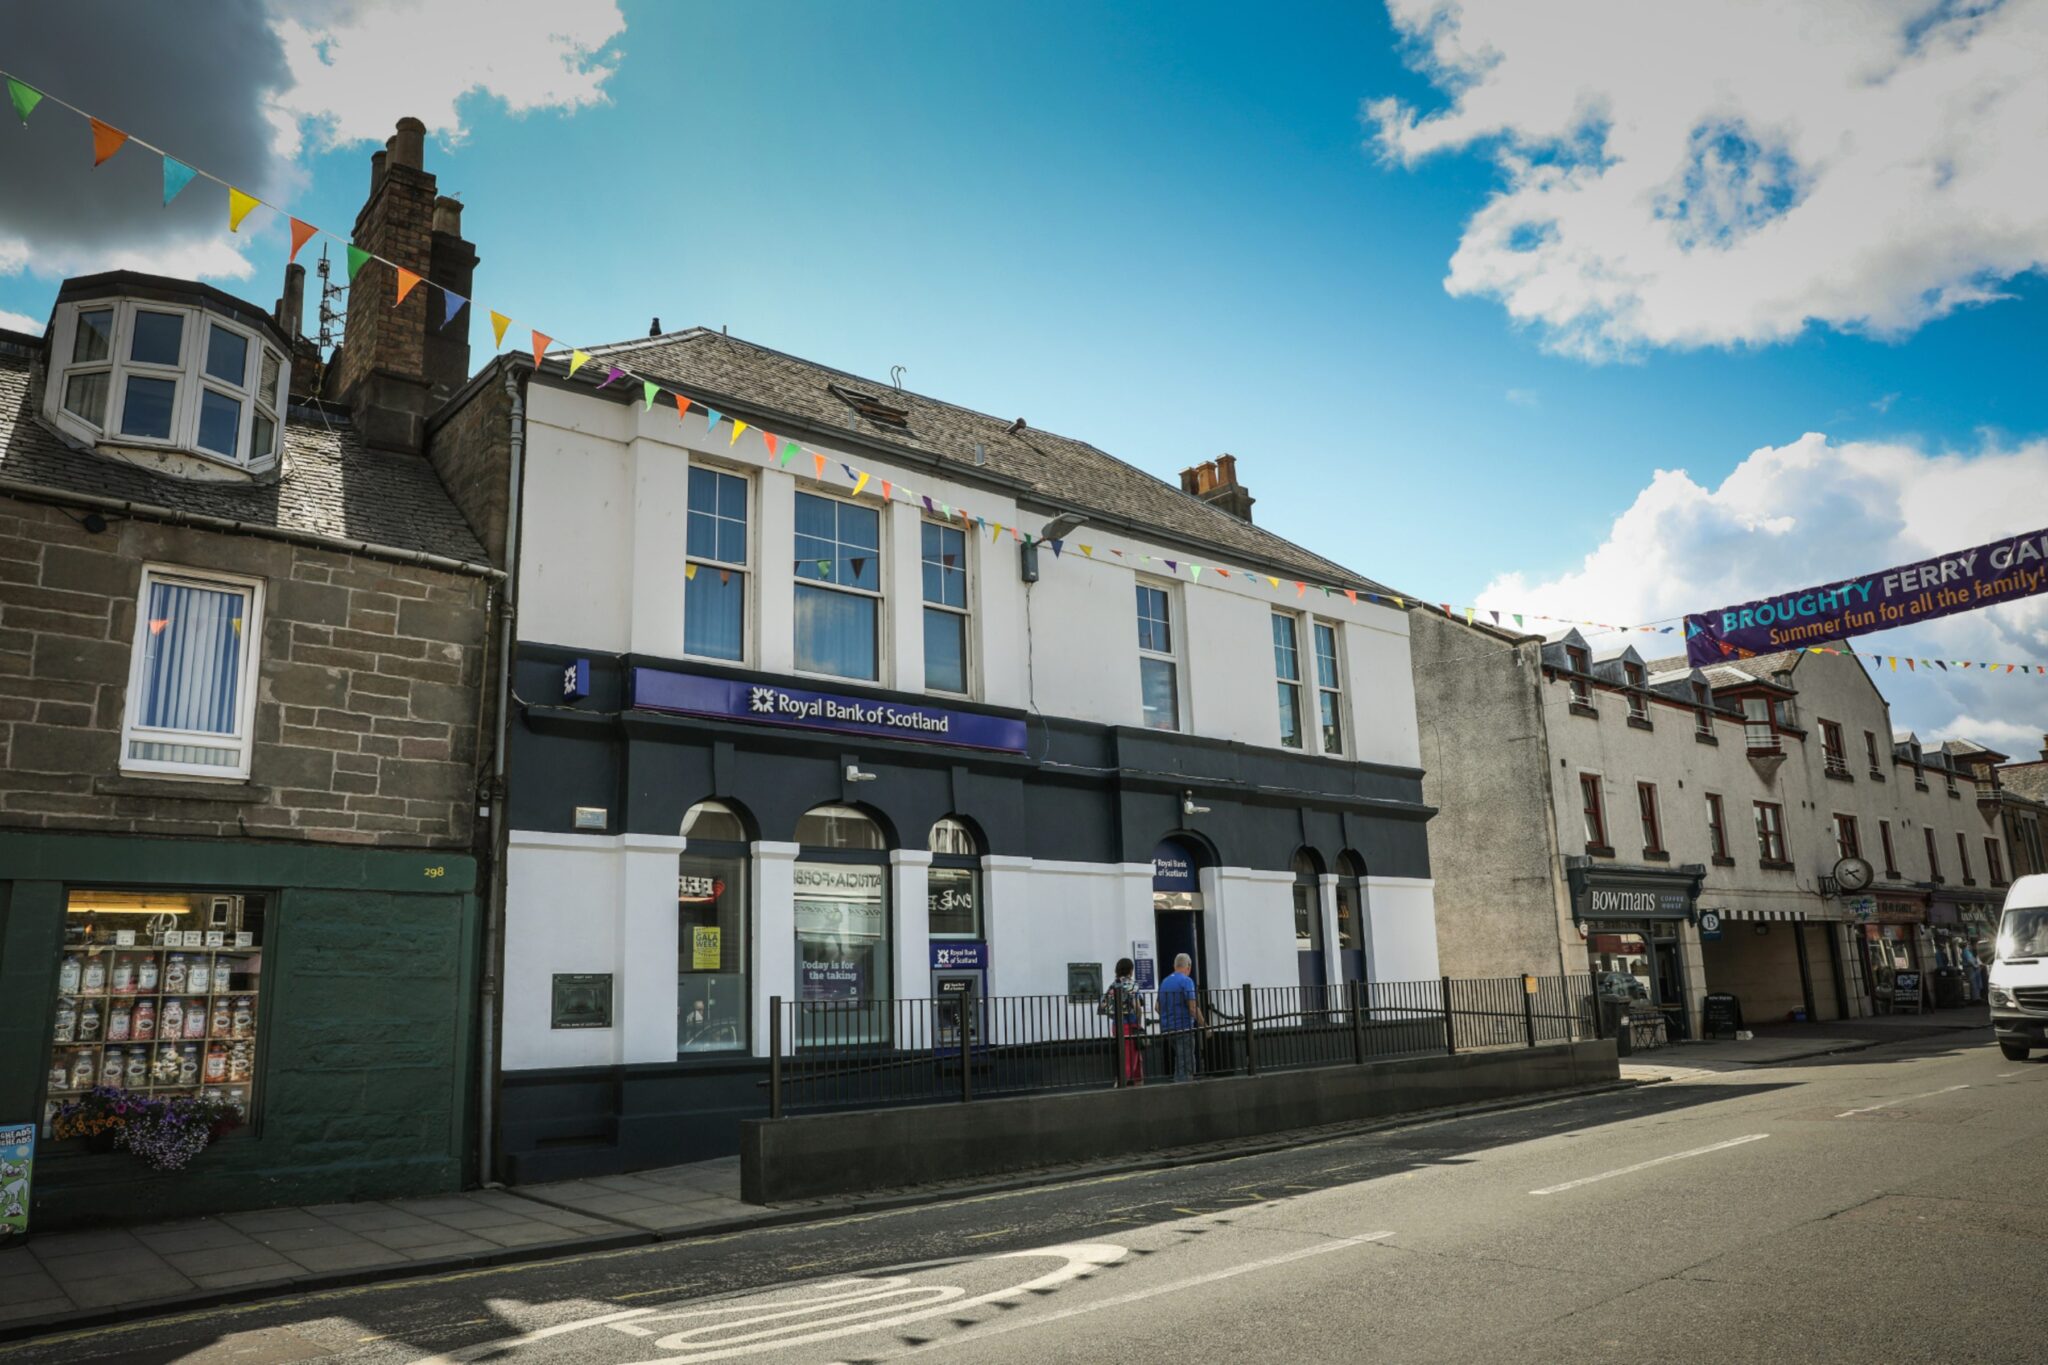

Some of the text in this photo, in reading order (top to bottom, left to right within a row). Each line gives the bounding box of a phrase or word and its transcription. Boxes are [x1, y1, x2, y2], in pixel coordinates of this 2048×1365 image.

[1722, 580, 1873, 633] BROUGHTY
[1882, 553, 1978, 597] FERRY
[1770, 565, 2047, 646] Summer fun for all the family!
[778, 693, 949, 733] Royal Bank of Scotland
[1157, 858, 1188, 869] Royal Bank
[423, 866, 445, 878] 298
[1158, 868, 1188, 878] of Scotland
[1707, 916, 1716, 928] B
[695, 933, 718, 941] GALA
[695, 940, 718, 948] WEEK
[950, 949, 964, 957] Royal
[802, 960, 855, 971] Today is for
[809, 970, 857, 982] the taking
